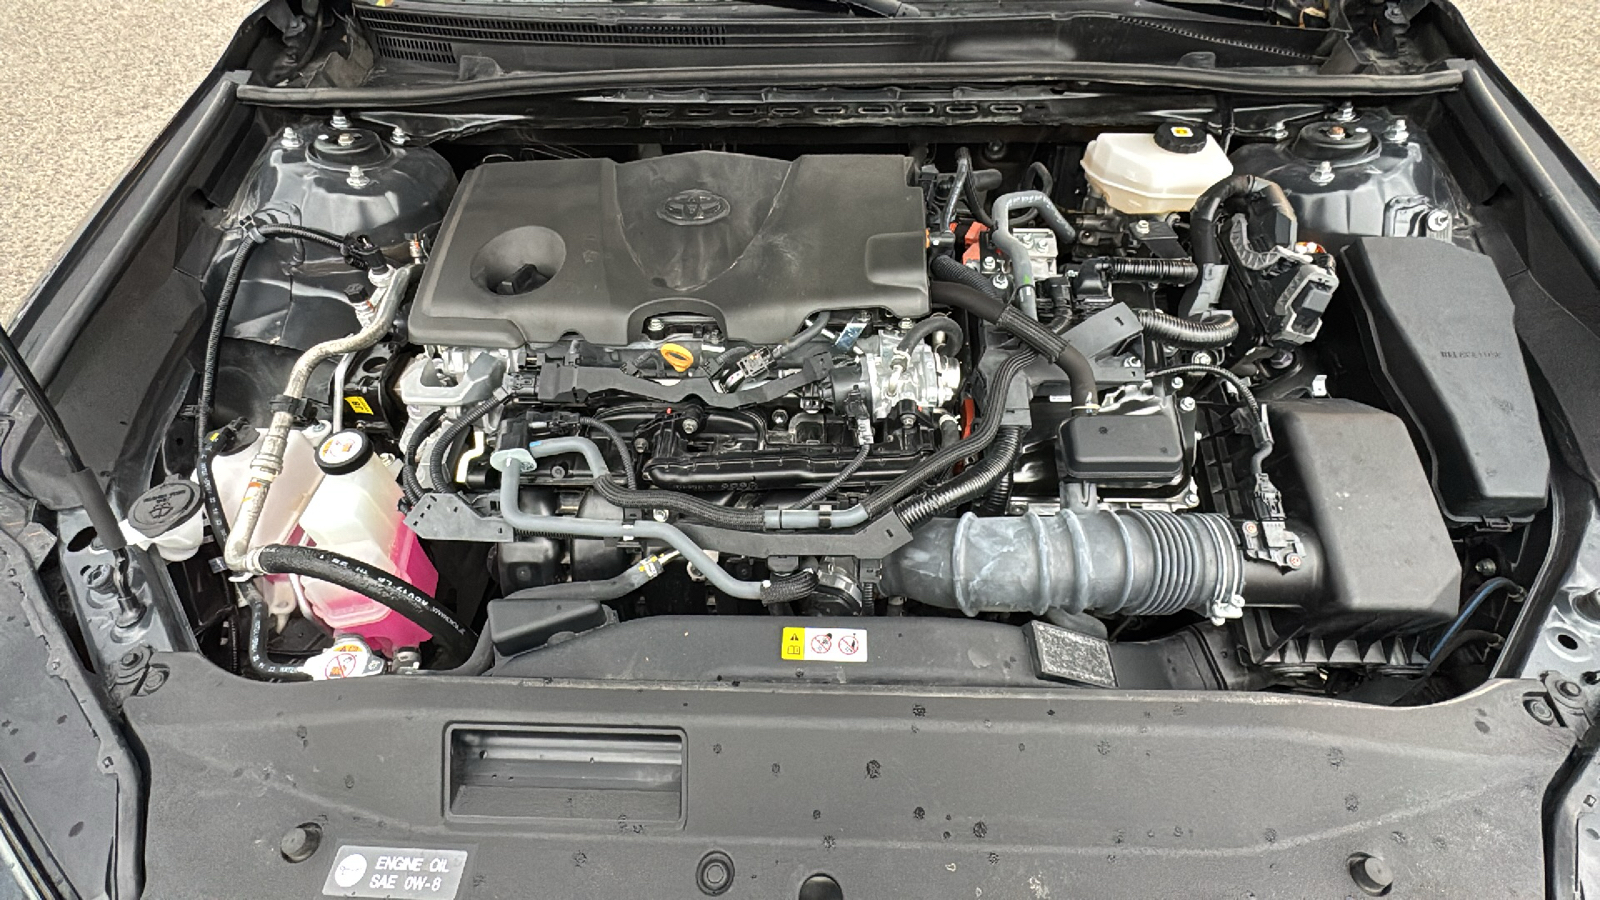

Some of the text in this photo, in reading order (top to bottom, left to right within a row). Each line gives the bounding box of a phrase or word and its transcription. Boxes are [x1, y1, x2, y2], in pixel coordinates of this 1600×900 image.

[375, 856, 450, 872] ENGINE OIL
[369, 874, 442, 892] SAE 0W-8
